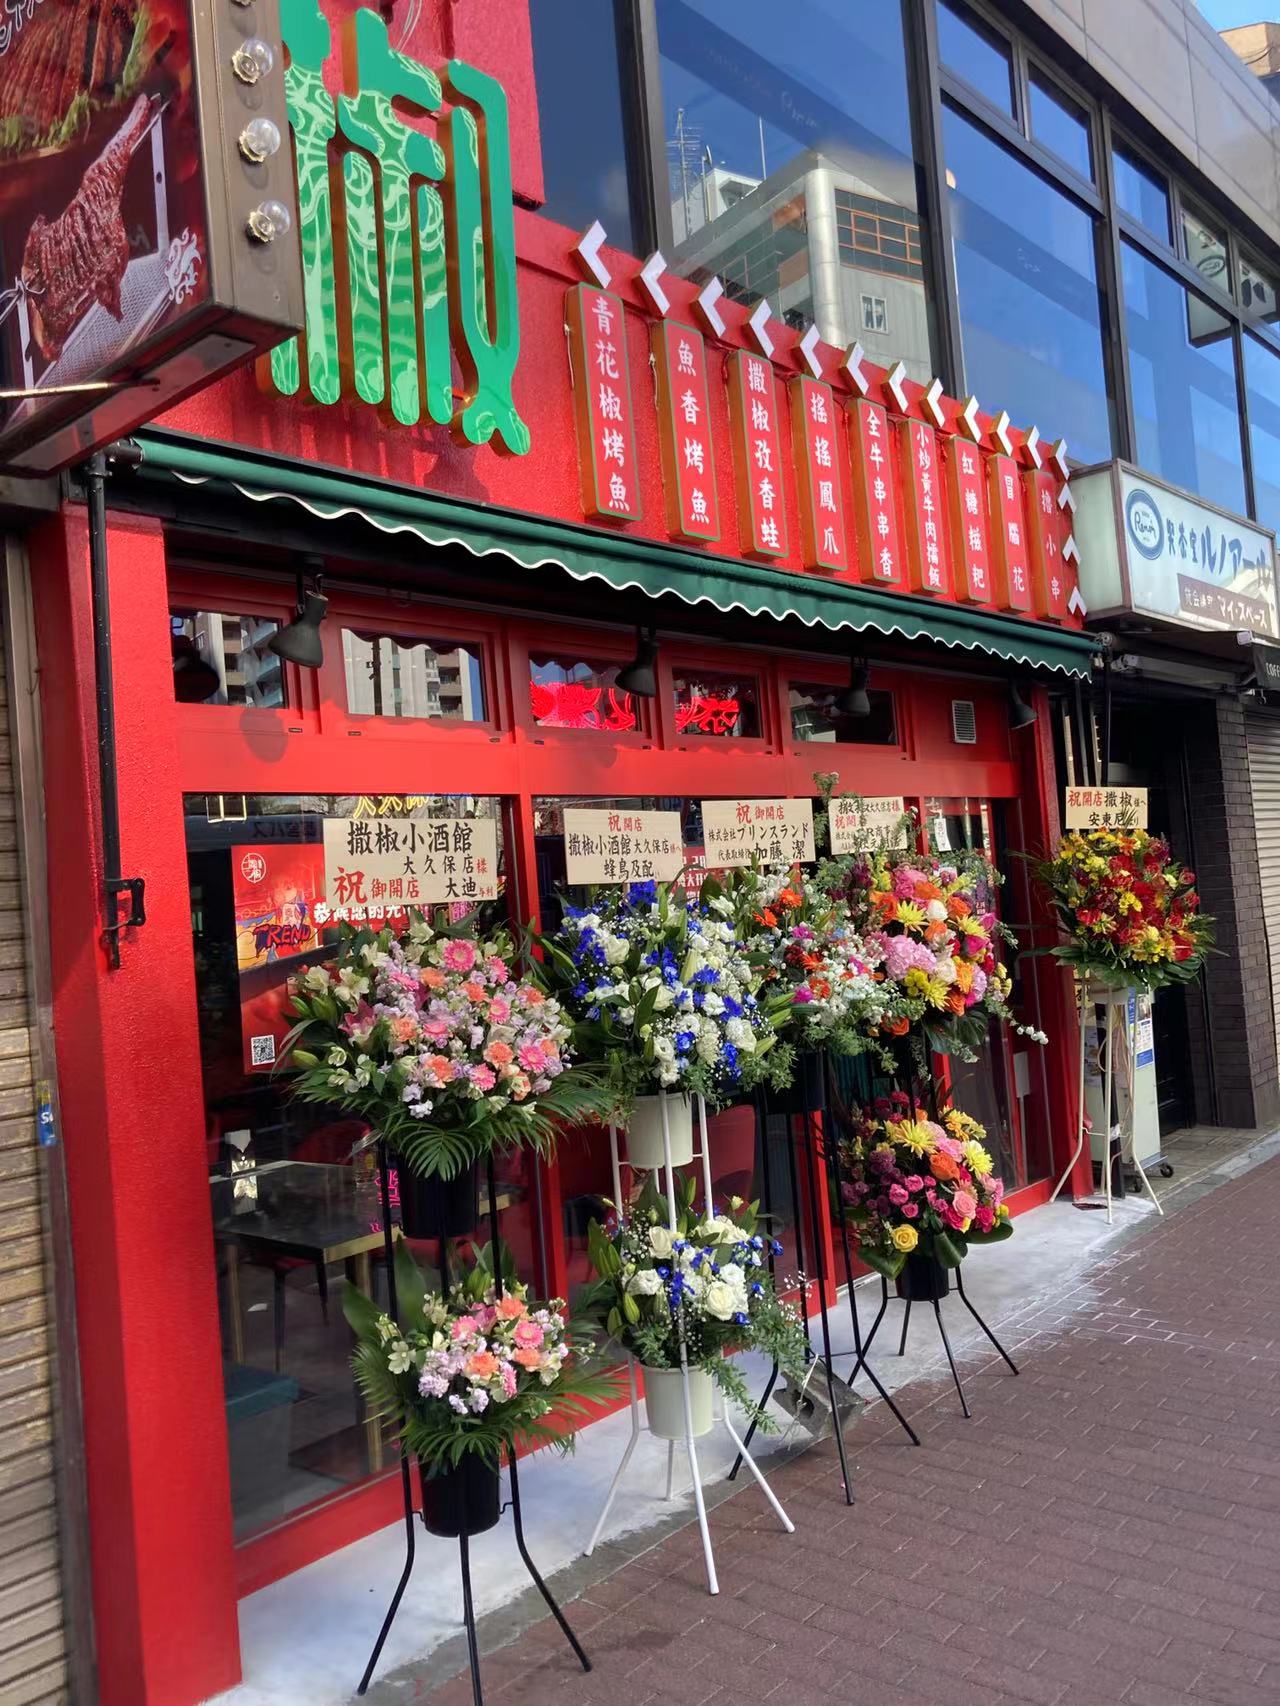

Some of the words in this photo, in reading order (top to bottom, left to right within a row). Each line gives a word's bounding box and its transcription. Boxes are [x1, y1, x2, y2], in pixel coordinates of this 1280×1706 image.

[592, 297, 630, 512] 青花椒烤魚
[677, 339, 710, 524] 魚香烤魚
[748, 360, 780, 548] 撒椒孜香蛙
[867, 409, 893, 577] 全牛串串香
[347, 820, 474, 856] 撒椒小酒館
